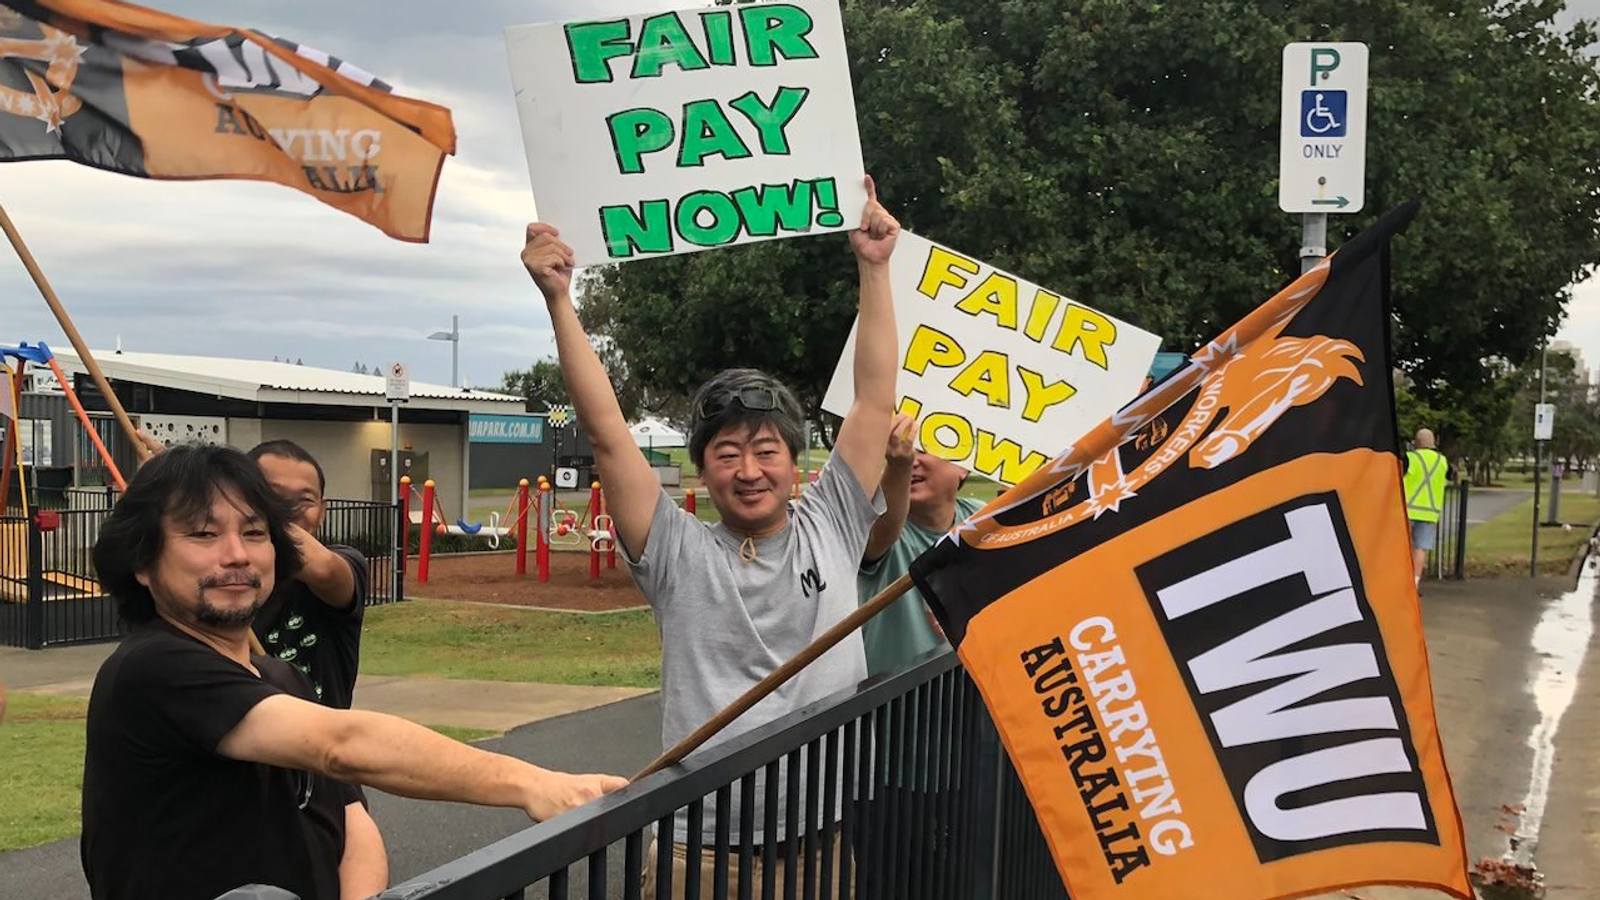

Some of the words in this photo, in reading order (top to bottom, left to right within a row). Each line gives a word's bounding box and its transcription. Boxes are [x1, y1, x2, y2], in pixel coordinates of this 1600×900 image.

[564, 4, 819, 83] FAIR
[1310, 48, 1341, 86] P
[605, 86, 809, 174] PAY
[1302, 144, 1343, 159] ONLY
[599, 177, 844, 258] NOW!
[917, 246, 1117, 370] FAIR
[903, 324, 1077, 423] PAY
[469, 420, 541, 439] UAPARK.COM.AU
[997, 513, 1074, 542] AUSTRALIA
[1157, 503, 1427, 841] TWU
[1021, 637, 1151, 884] AUSTRALIA
[1069, 616, 1195, 856] CARRYING
